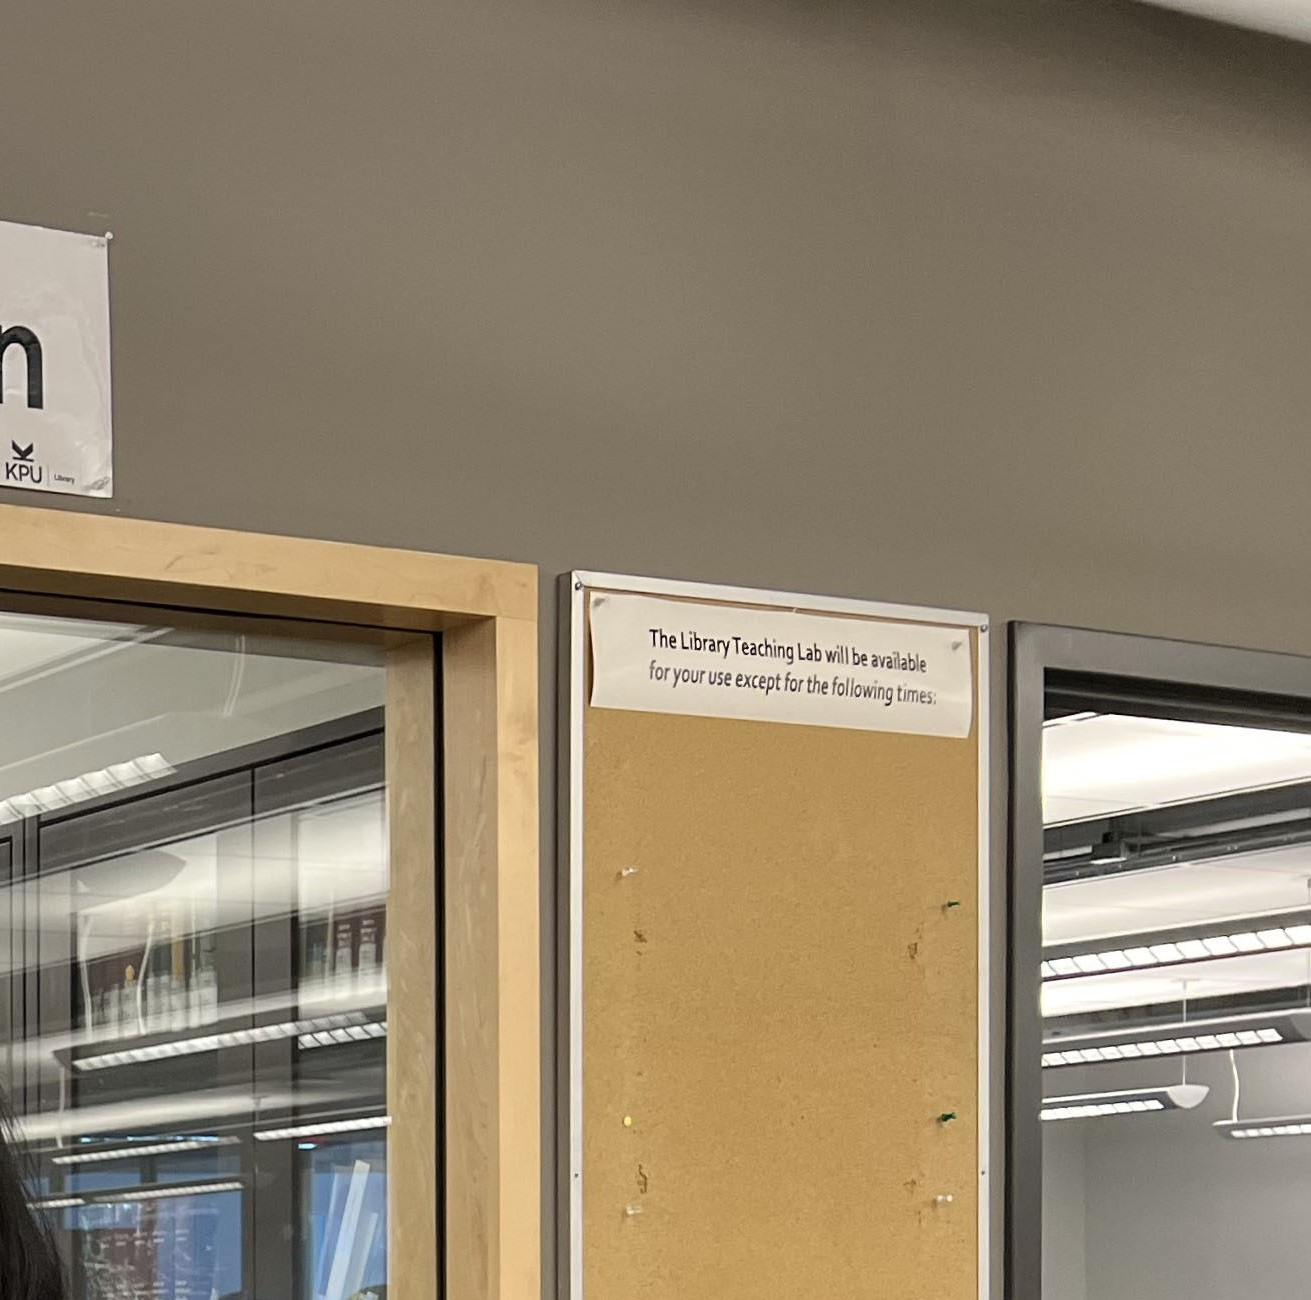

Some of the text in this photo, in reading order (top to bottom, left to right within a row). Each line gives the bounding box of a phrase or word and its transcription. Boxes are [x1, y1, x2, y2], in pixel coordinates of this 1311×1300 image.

[6, 462, 41, 483] KPU
[649, 628, 926, 673] The Library Teaching Lab will be available
[649, 661, 936, 705] for your use except for the following times:
